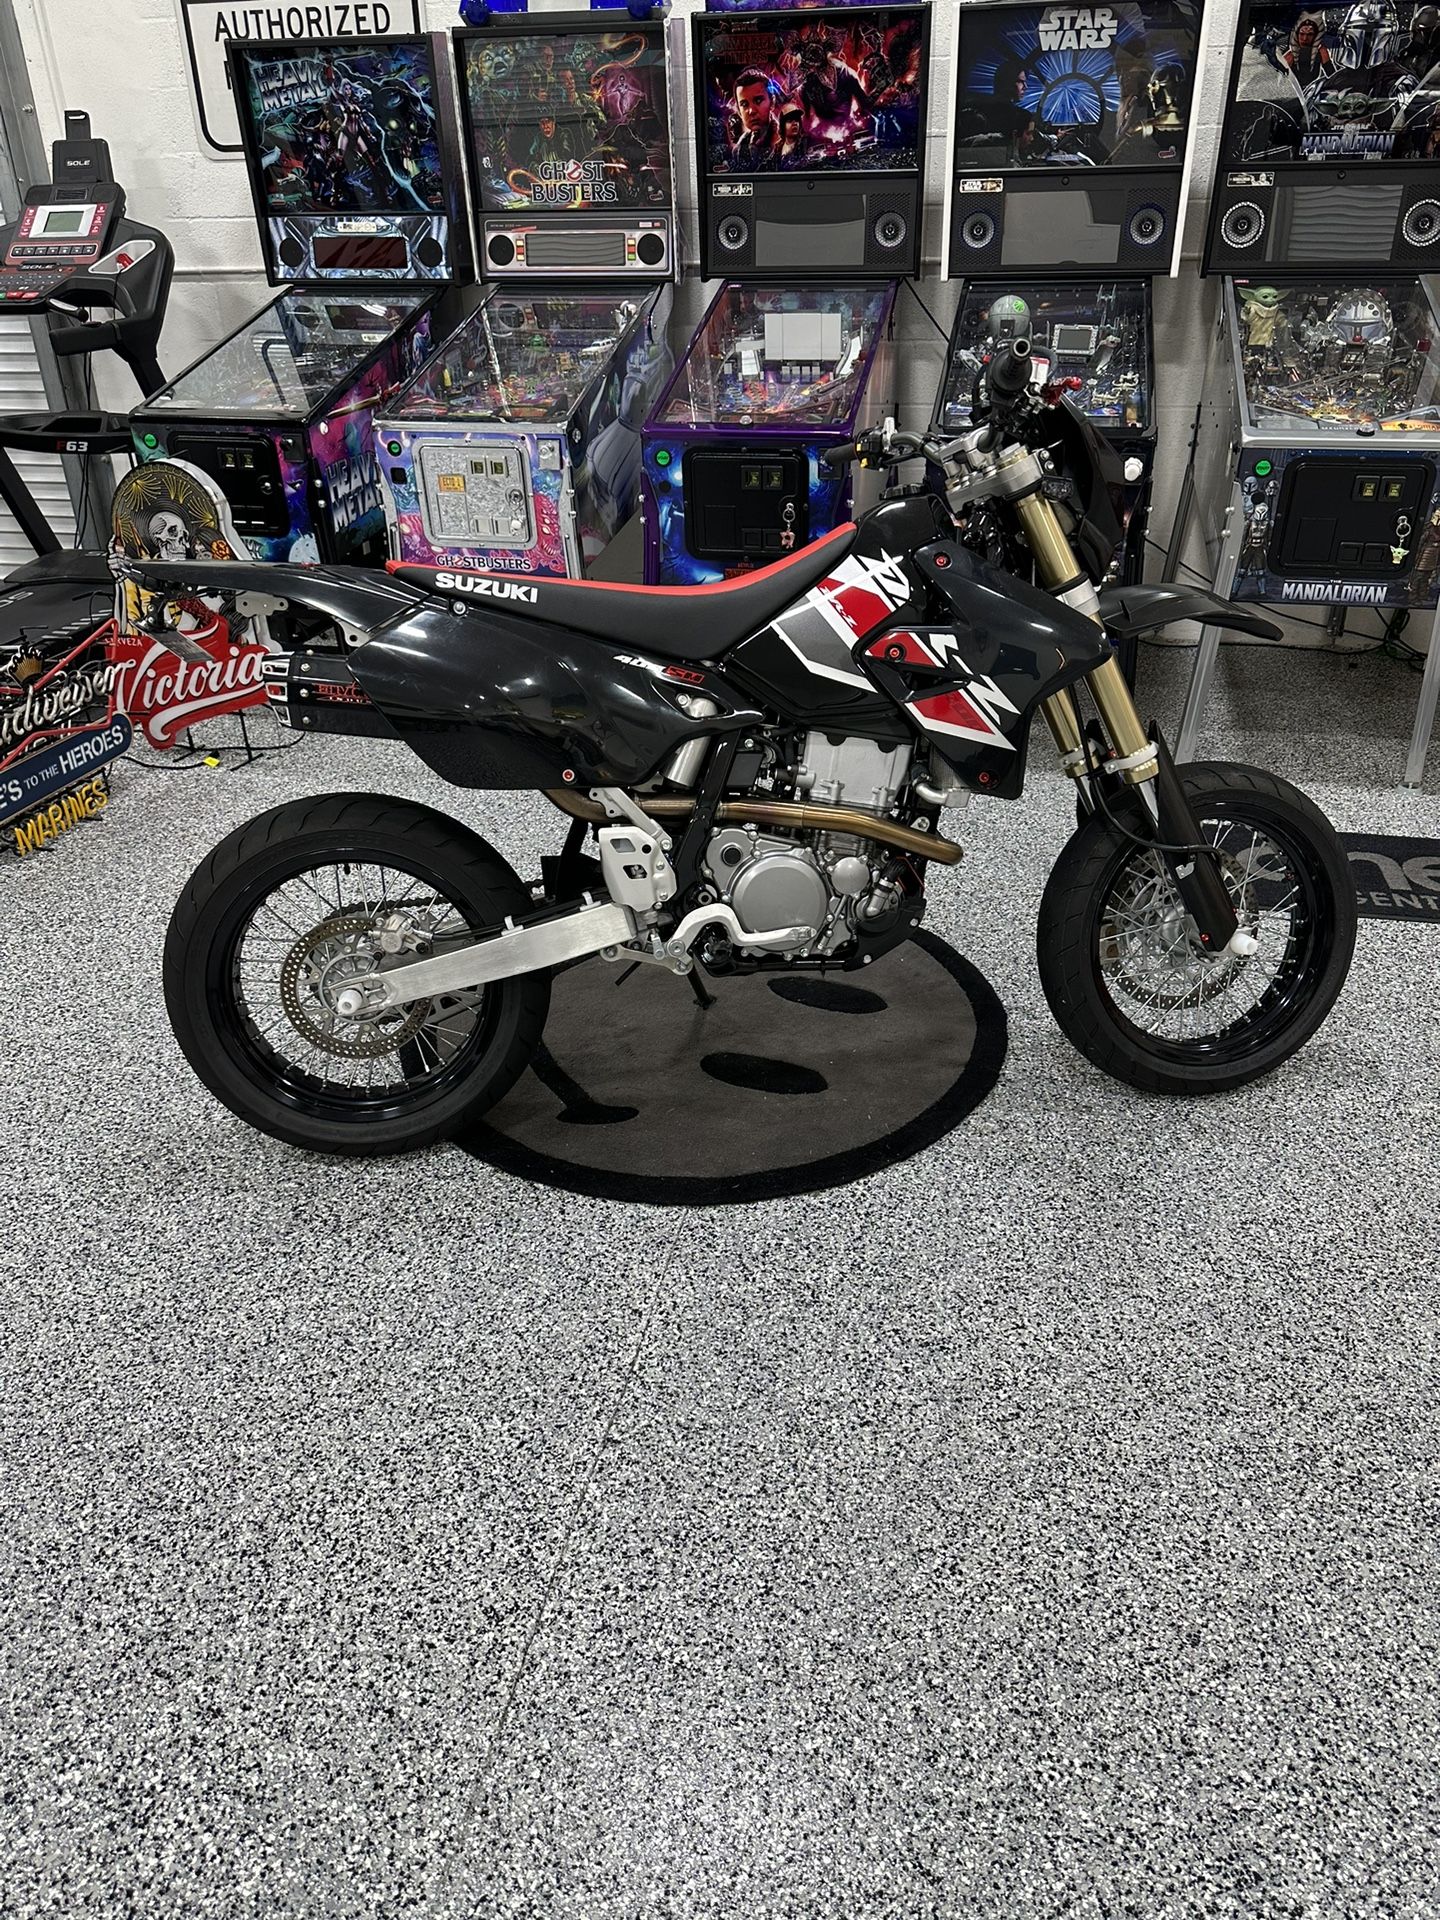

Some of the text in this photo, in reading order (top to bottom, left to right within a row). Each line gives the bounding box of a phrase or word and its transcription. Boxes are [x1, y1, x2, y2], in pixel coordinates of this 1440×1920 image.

[215, 3, 391, 42] AUTHORIZED
[1039, 8, 1118, 31] STAR
[1039, 28, 1117, 51] WARS
[253, 60, 325, 92] HEAVY
[262, 81, 328, 112] METAL
[531, 182, 618, 202] BUSTERS
[332, 485, 384, 534] META
[436, 555, 531, 570] GHOSTBUSTERS
[435, 572, 538, 604] SUZUKI
[1282, 582, 1388, 603] MANDALORIAN
[114, 638, 267, 712] Victoria
[24, 778, 39, 790] TO
[39, 763, 60, 782] THE
[59, 724, 124, 775] HEROES
[15, 778, 109, 857] MARINES
